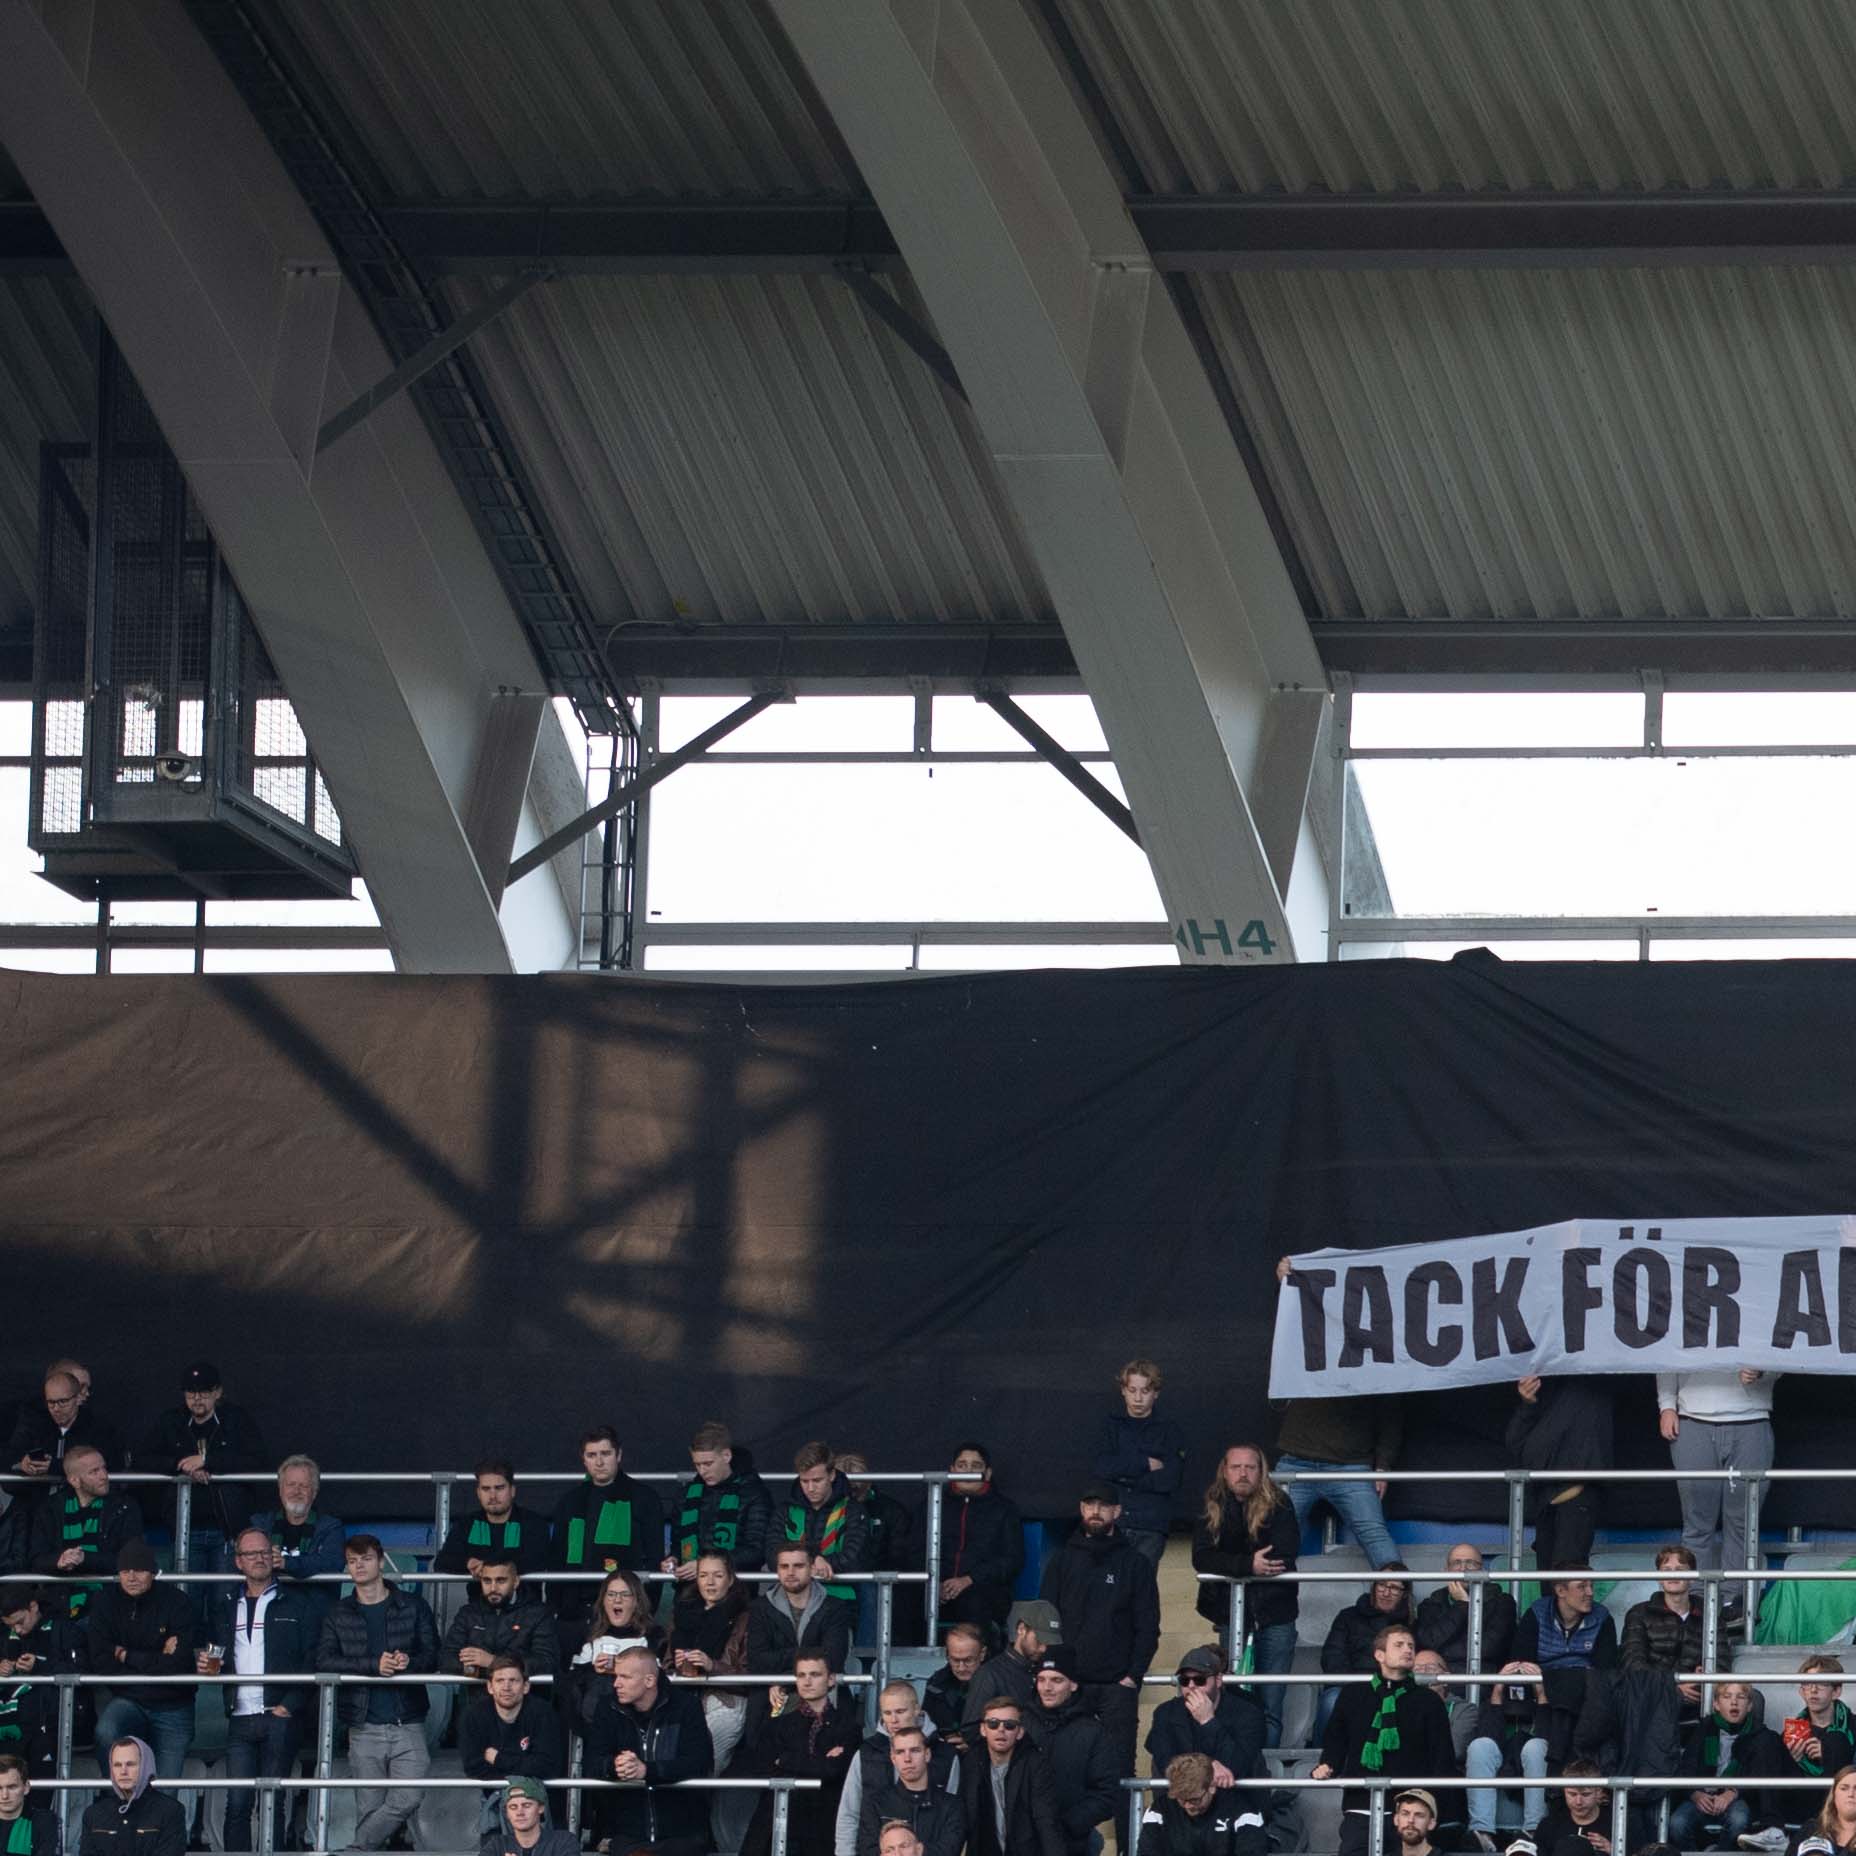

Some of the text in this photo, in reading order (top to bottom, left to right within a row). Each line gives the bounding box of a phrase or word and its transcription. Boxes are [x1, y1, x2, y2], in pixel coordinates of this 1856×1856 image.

[1186, 919, 1276, 955] H4
[1286, 1256, 1535, 1372] TACK
[1562, 1227, 1741, 1354] FÖR
